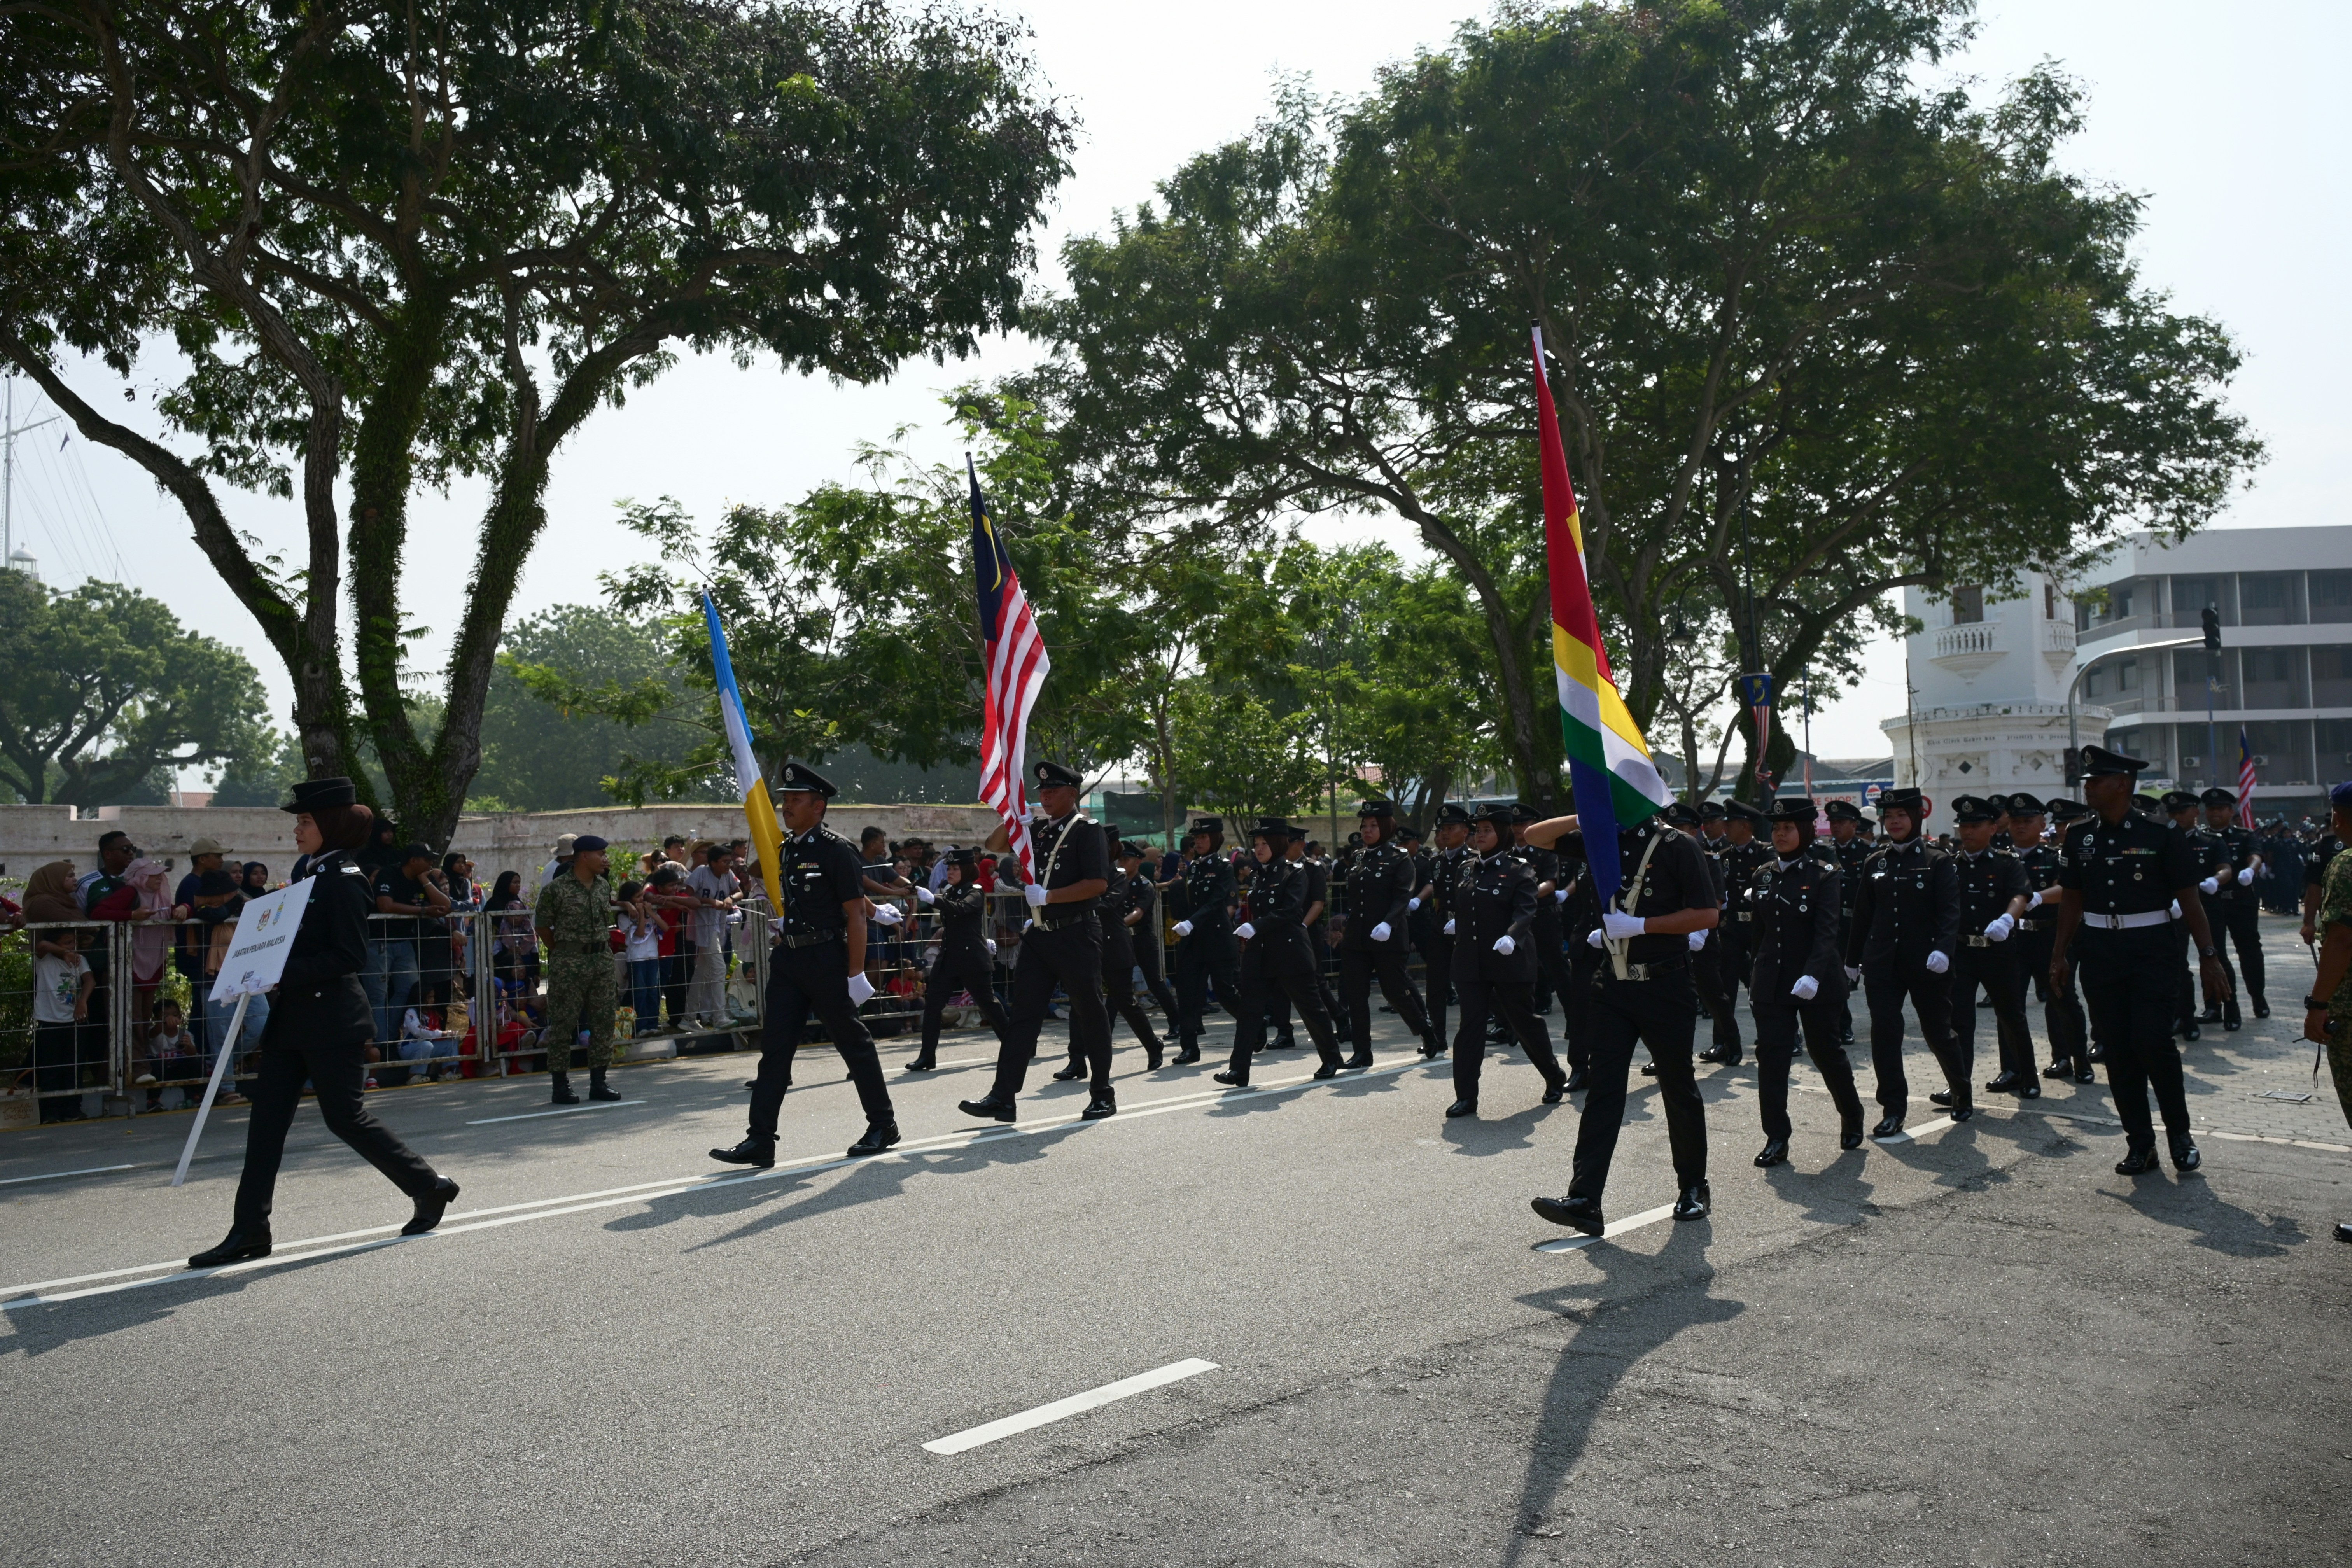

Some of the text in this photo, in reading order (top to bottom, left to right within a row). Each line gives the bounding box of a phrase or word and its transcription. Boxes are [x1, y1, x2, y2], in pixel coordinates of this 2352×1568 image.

[232, 934, 286, 959] JABATAN PENJARA MALAYSIA
